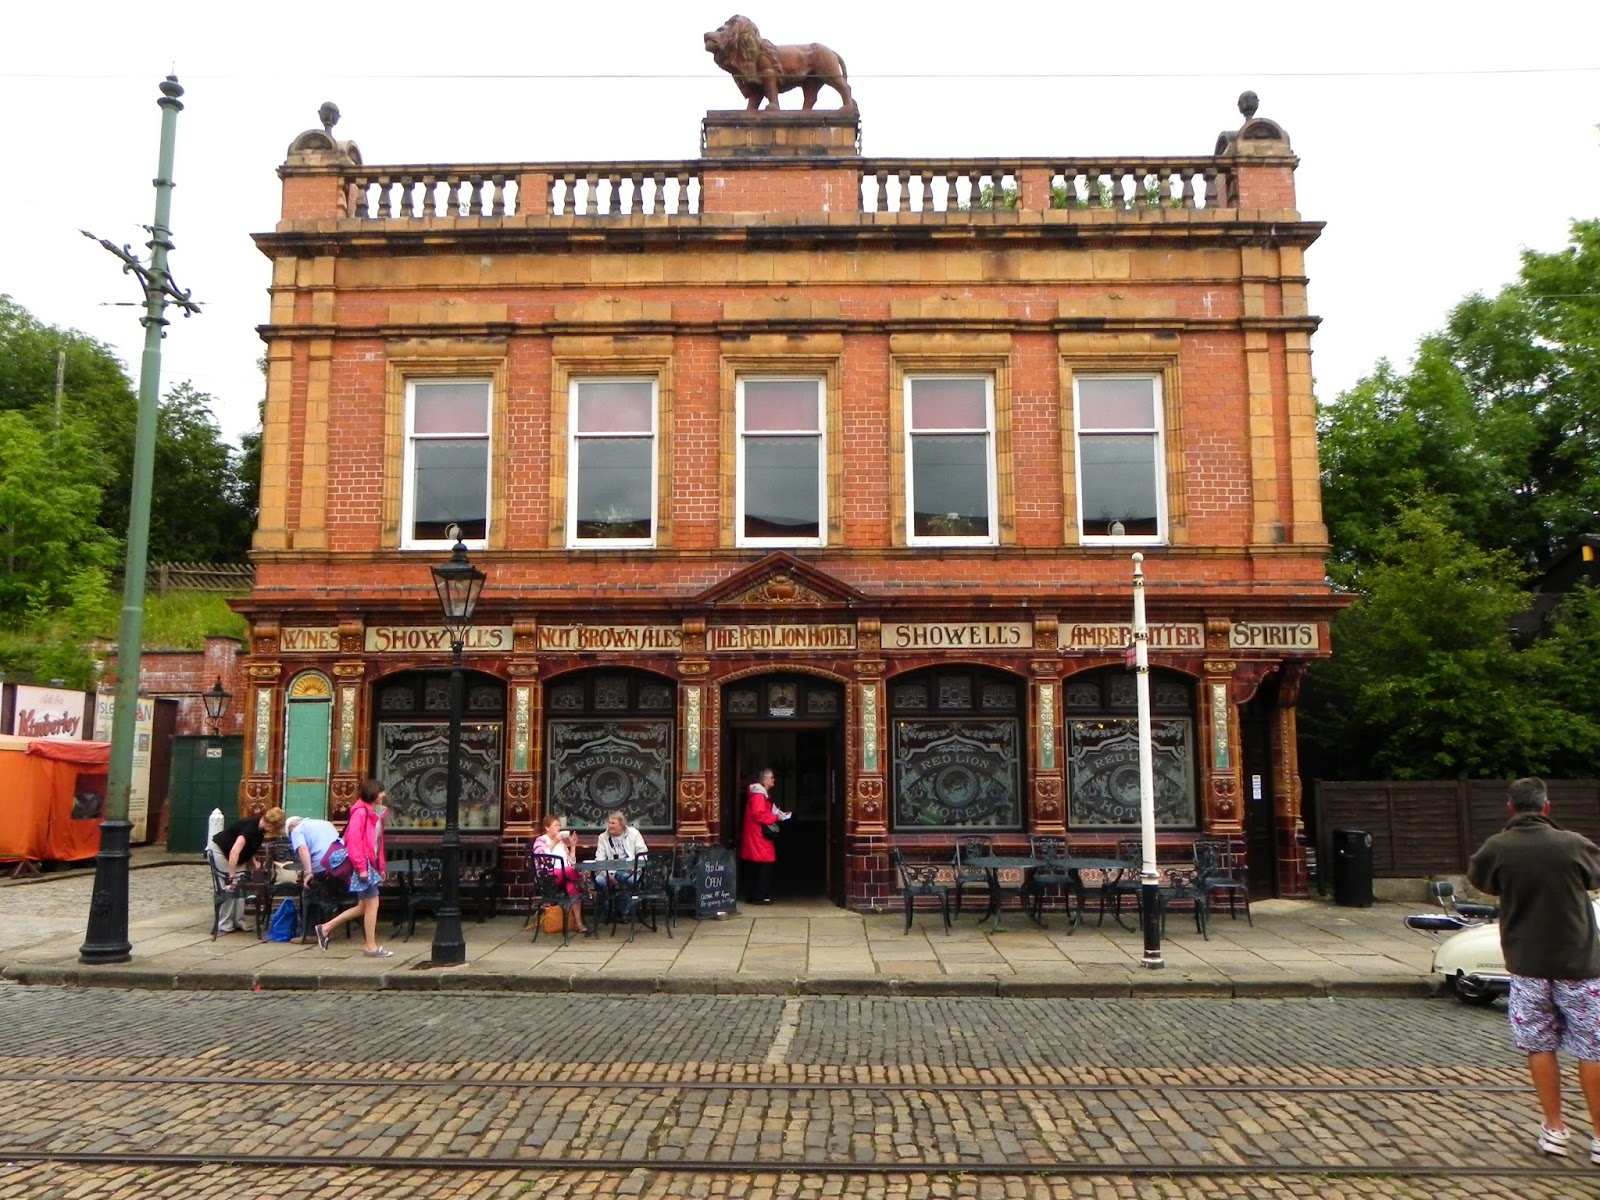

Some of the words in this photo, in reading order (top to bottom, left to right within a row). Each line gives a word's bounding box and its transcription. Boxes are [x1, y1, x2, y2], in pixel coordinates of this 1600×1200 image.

[282, 628, 340, 650] WINES
[375, 628, 503, 651] SHOWLL'S
[537, 626, 574, 650] NUT
[573, 626, 639, 650] BROWN
[635, 626, 683, 650] ALES
[704, 626, 739, 650] THE
[739, 626, 770, 649] RED
[770, 625, 808, 647] LION
[808, 624, 855, 647] HOTEL
[896, 625, 1021, 647] SHOWELL'S
[1064, 625, 1132, 647] AMBER
[1147, 624, 1201, 646] ITTER
[1234, 623, 1312, 646] SPIRITS
[19, 709, 80, 737] Kimberley
[405, 756, 435, 771] RED
[440, 756, 472, 770] LN
[575, 756, 605, 770] RED
[610, 756, 643, 769] LION
[920, 755, 951, 770] RED
[956, 755, 989, 768] LION
[1094, 753, 1124, 768] RED
[1129, 753, 1162, 767] LN
[927, 801, 987, 819] HOTEL
[705, 876, 722, 888] OPEN
